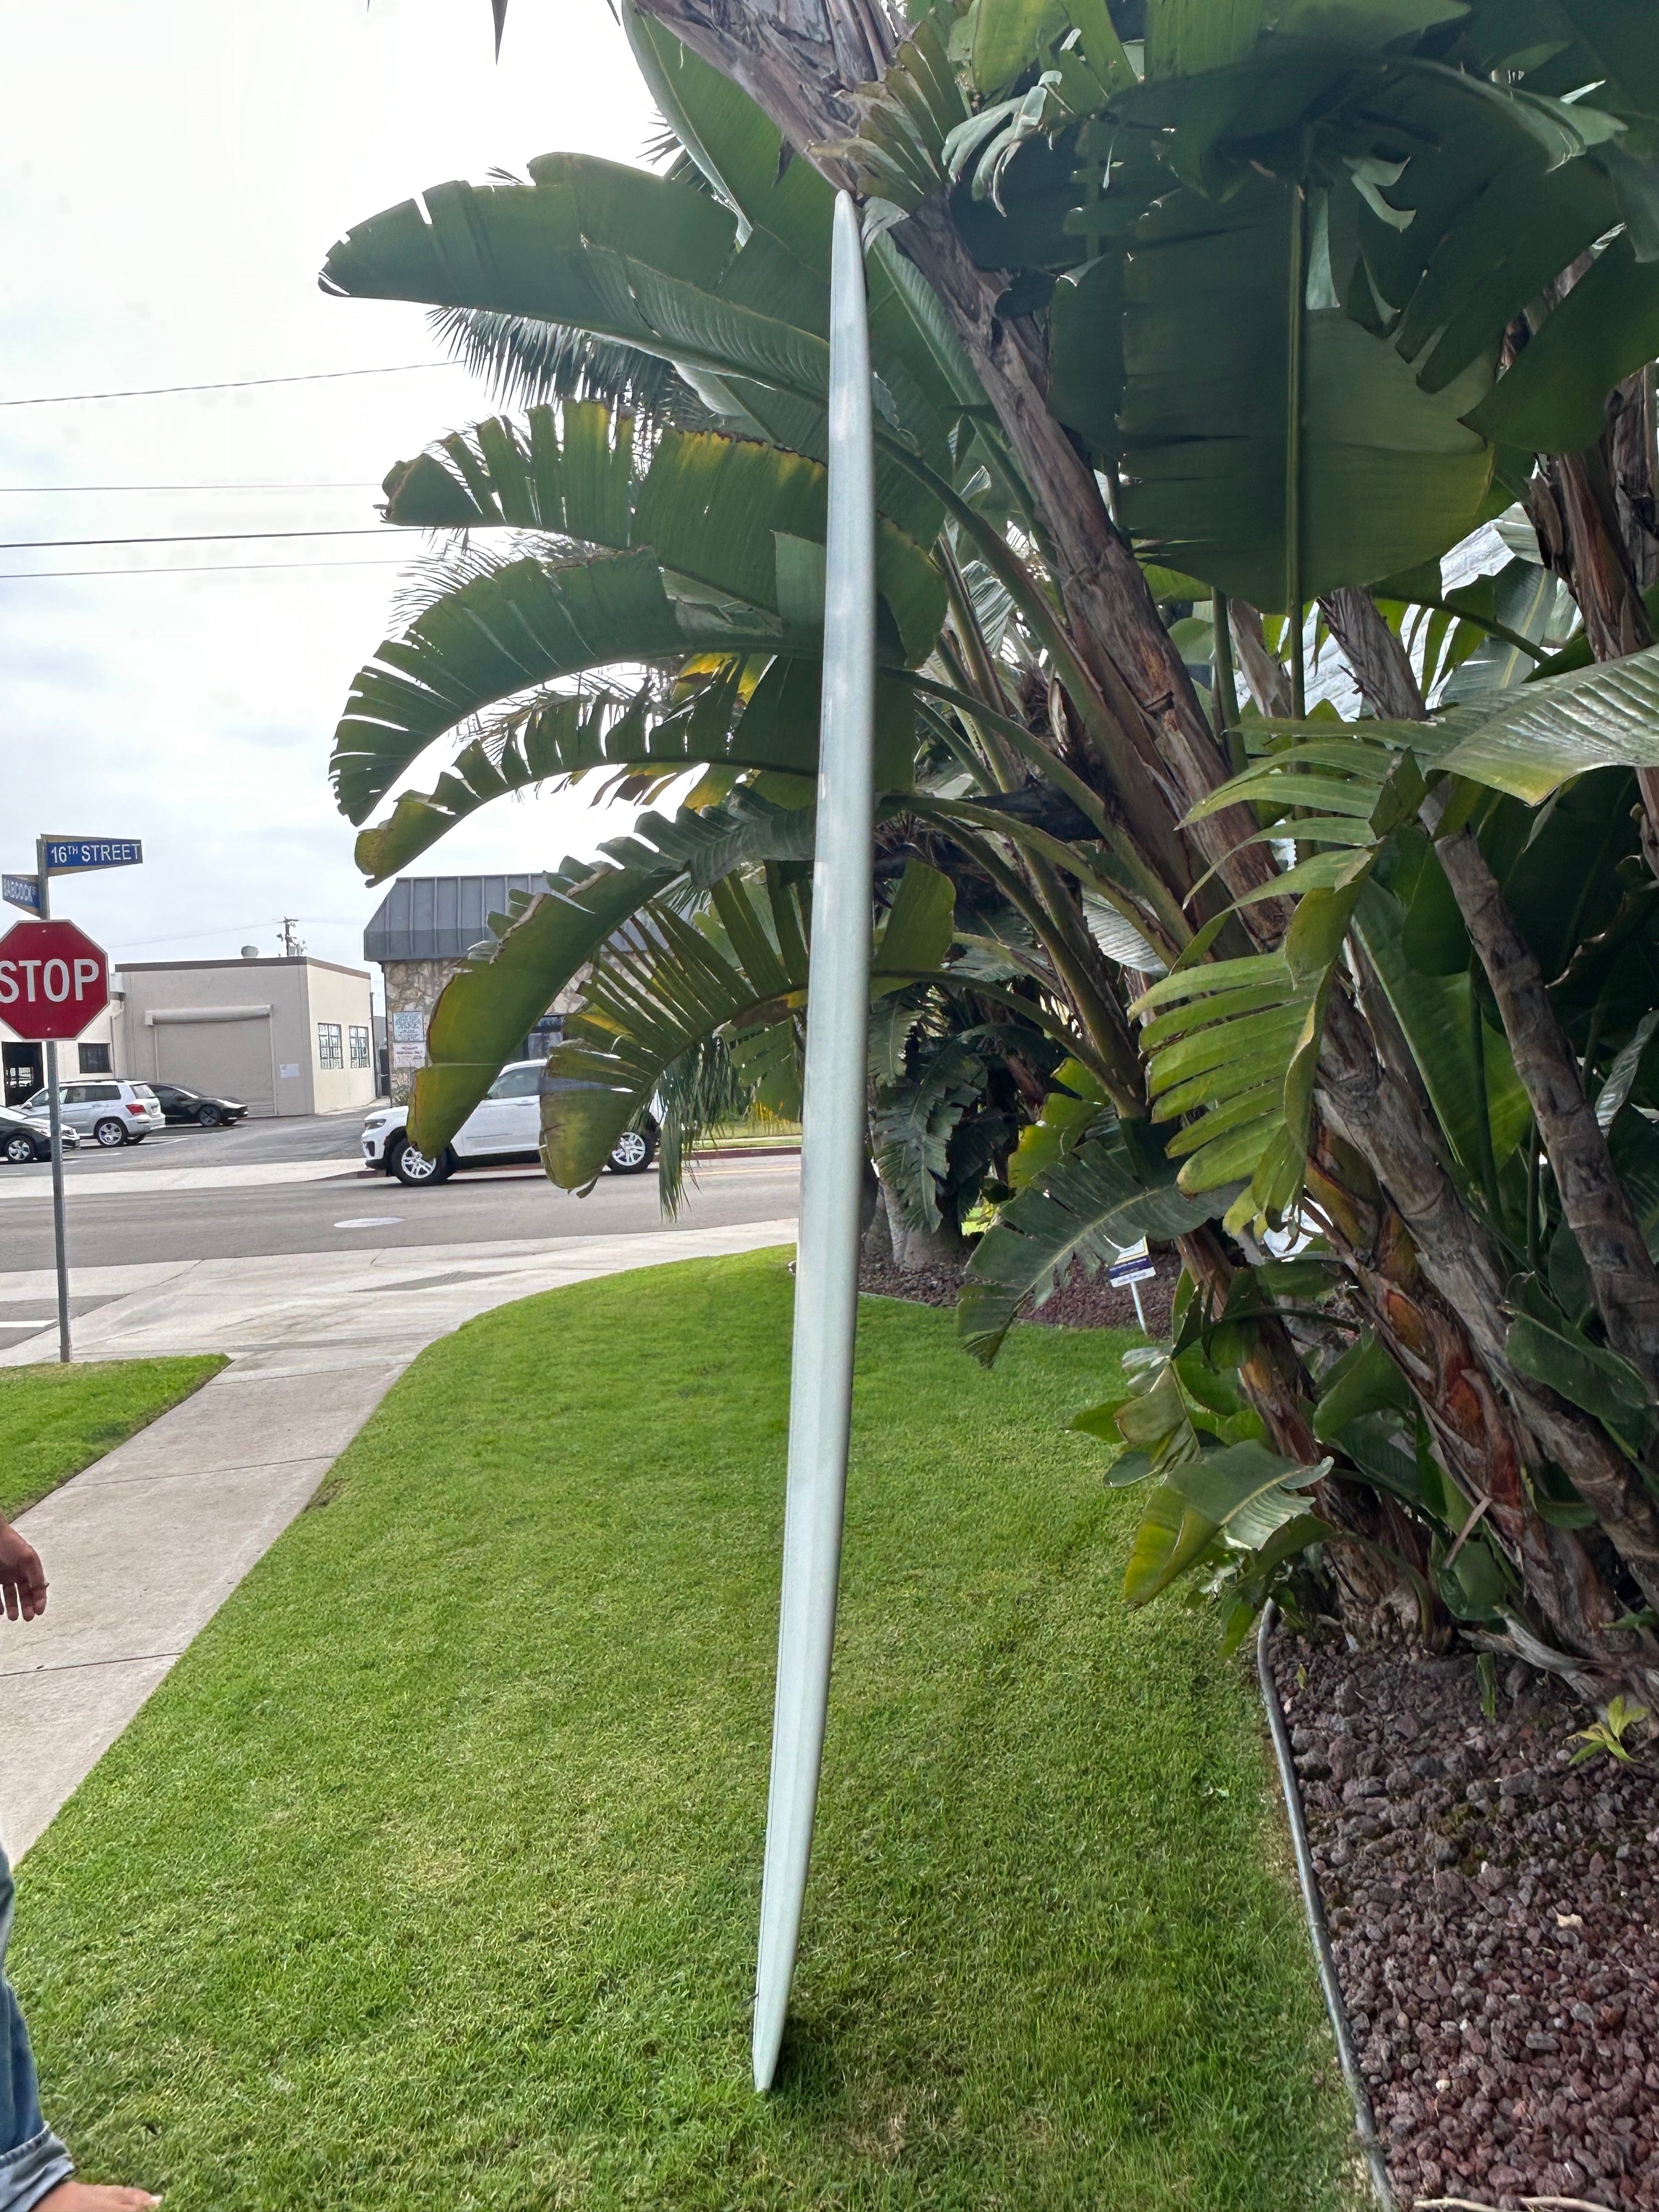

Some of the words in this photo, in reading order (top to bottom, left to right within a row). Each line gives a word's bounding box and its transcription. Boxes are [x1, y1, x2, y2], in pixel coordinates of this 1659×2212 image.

[51, 845, 78, 864] 16TH
[81, 843, 140, 862] STREET
[0, 958, 99, 1003] STOP
